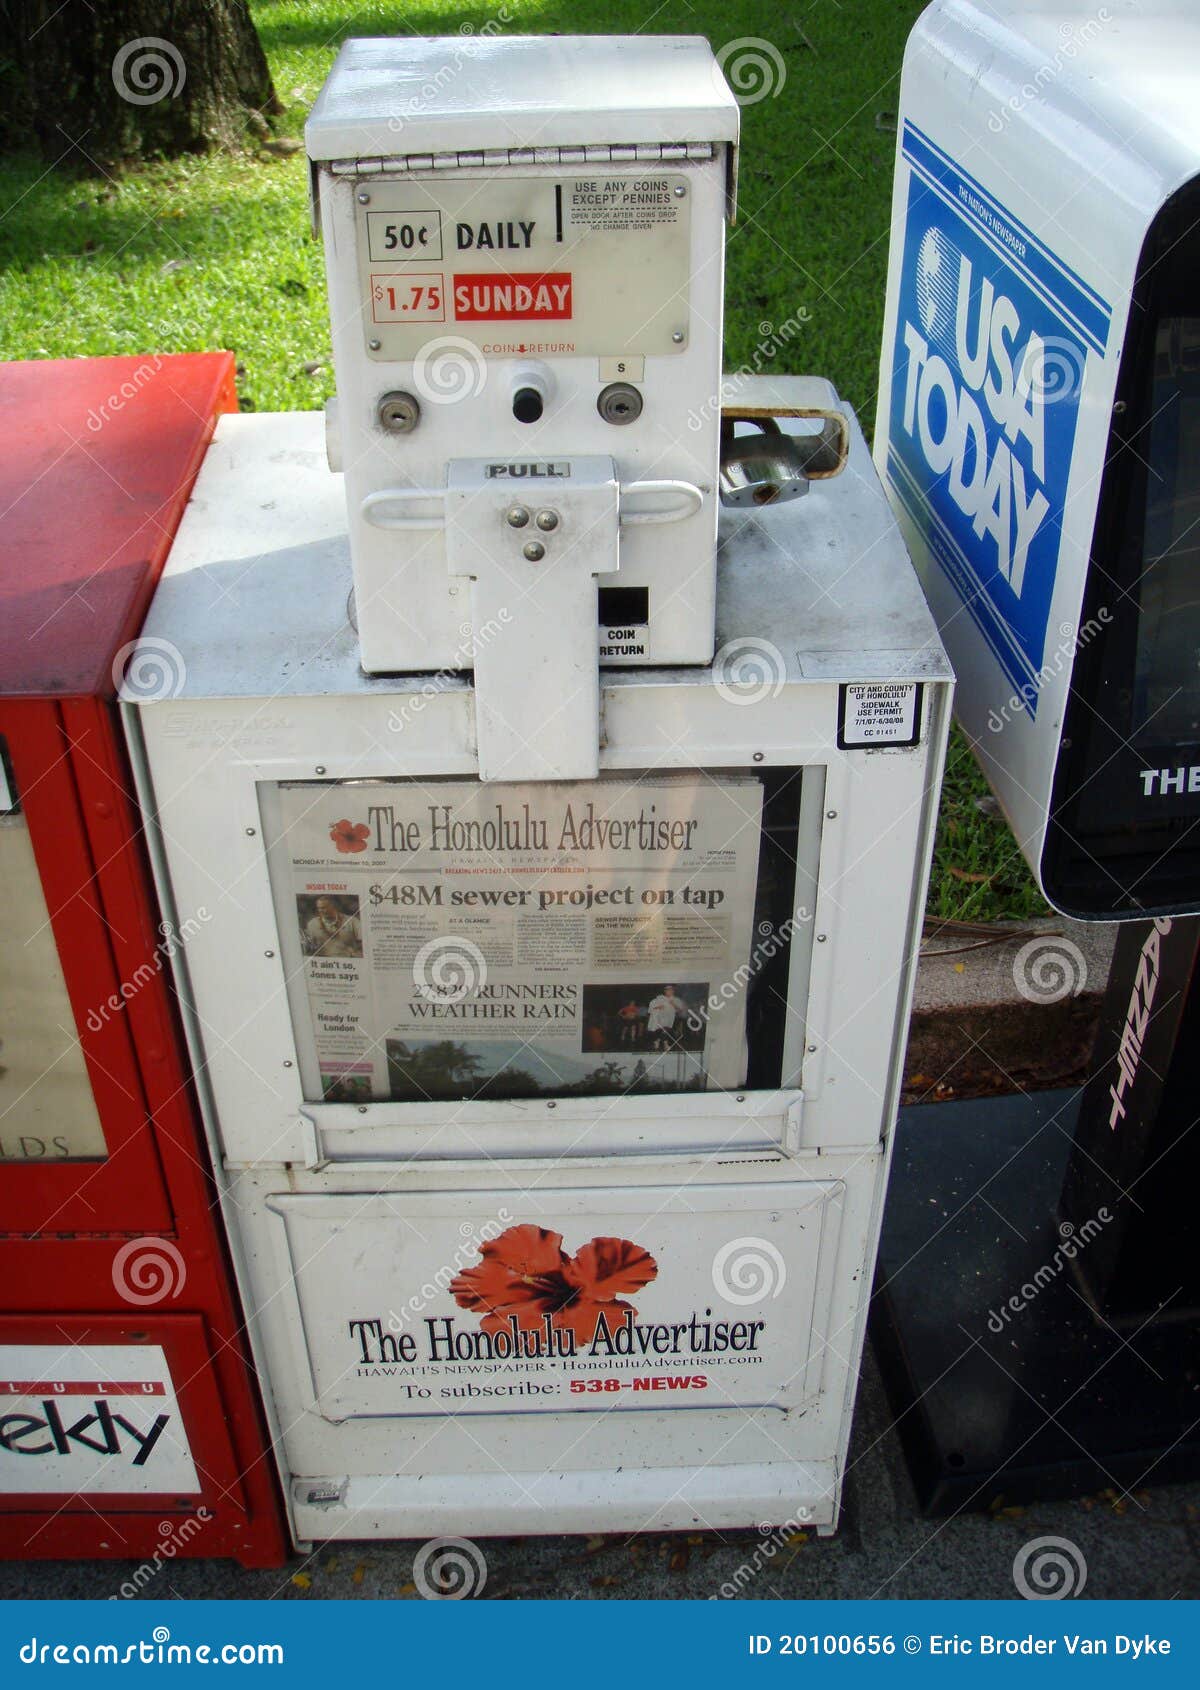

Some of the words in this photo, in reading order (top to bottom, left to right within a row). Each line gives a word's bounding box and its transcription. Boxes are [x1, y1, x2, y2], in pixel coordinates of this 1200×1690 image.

[575, 182, 597, 192] USE
[604, 181, 627, 192] ANY
[633, 181, 669, 191] COINS
[572, 194, 617, 205] EXCEPT
[623, 193, 671, 204] PENNIES
[959, 184, 968, 202] THE
[992, 218, 1026, 259] NEWSPAPER
[384, 224, 429, 250] 50¢
[456, 221, 536, 250] DAILY
[374, 284, 441, 312] $1.75
[455, 284, 571, 313] SUNDAY
[482, 344, 515, 353] COIN
[529, 343, 576, 353] RETURN
[617, 363, 625, 373] S
[955, 252, 1045, 485] USA
[904, 320, 1050, 600] TODAY
[489, 464, 564, 478] PULL
[607, 630, 636, 640] COIN
[599, 645, 645, 656] RETURN
[849, 686, 866, 694] CITY
[884, 684, 914, 692] COUNTY
[861, 701, 900, 709] SIDEWALK
[874, 708, 903, 716] PERMIT
[1140, 766, 1200, 795] THE
[368, 806, 421, 852] The
[428, 804, 549, 852] Honolulu
[558, 803, 698, 851] Advertiser
[369, 883, 444, 907] $48M
[451, 889, 531, 906] sewer
[538, 884, 634, 910] project
[641, 888, 675, 905] on
[681, 885, 725, 910] tap
[311, 960, 318, 968] It
[342, 962, 356, 970] so,
[310, 971, 336, 980] Jones
[339, 973, 359, 981] says
[477, 984, 577, 999] RUNNERS
[408, 1004, 516, 1018] WEATHER
[523, 1003, 577, 1018] RAIN
[318, 1014, 344, 1024] Ready
[347, 1014, 359, 1022] for
[324, 1024, 355, 1032] London
[349, 1318, 417, 1364] The
[424, 1313, 577, 1362] Honolulu
[589, 1308, 764, 1357] Advertiser
[445, 1363, 546, 1374] NEWSPAPER
[563, 1356, 763, 1370] HonoluluAdvertiser.com
[400, 1384, 432, 1399] To
[441, 1382, 561, 1398] subscribe:
[570, 1376, 708, 1393] 538-NEWS
